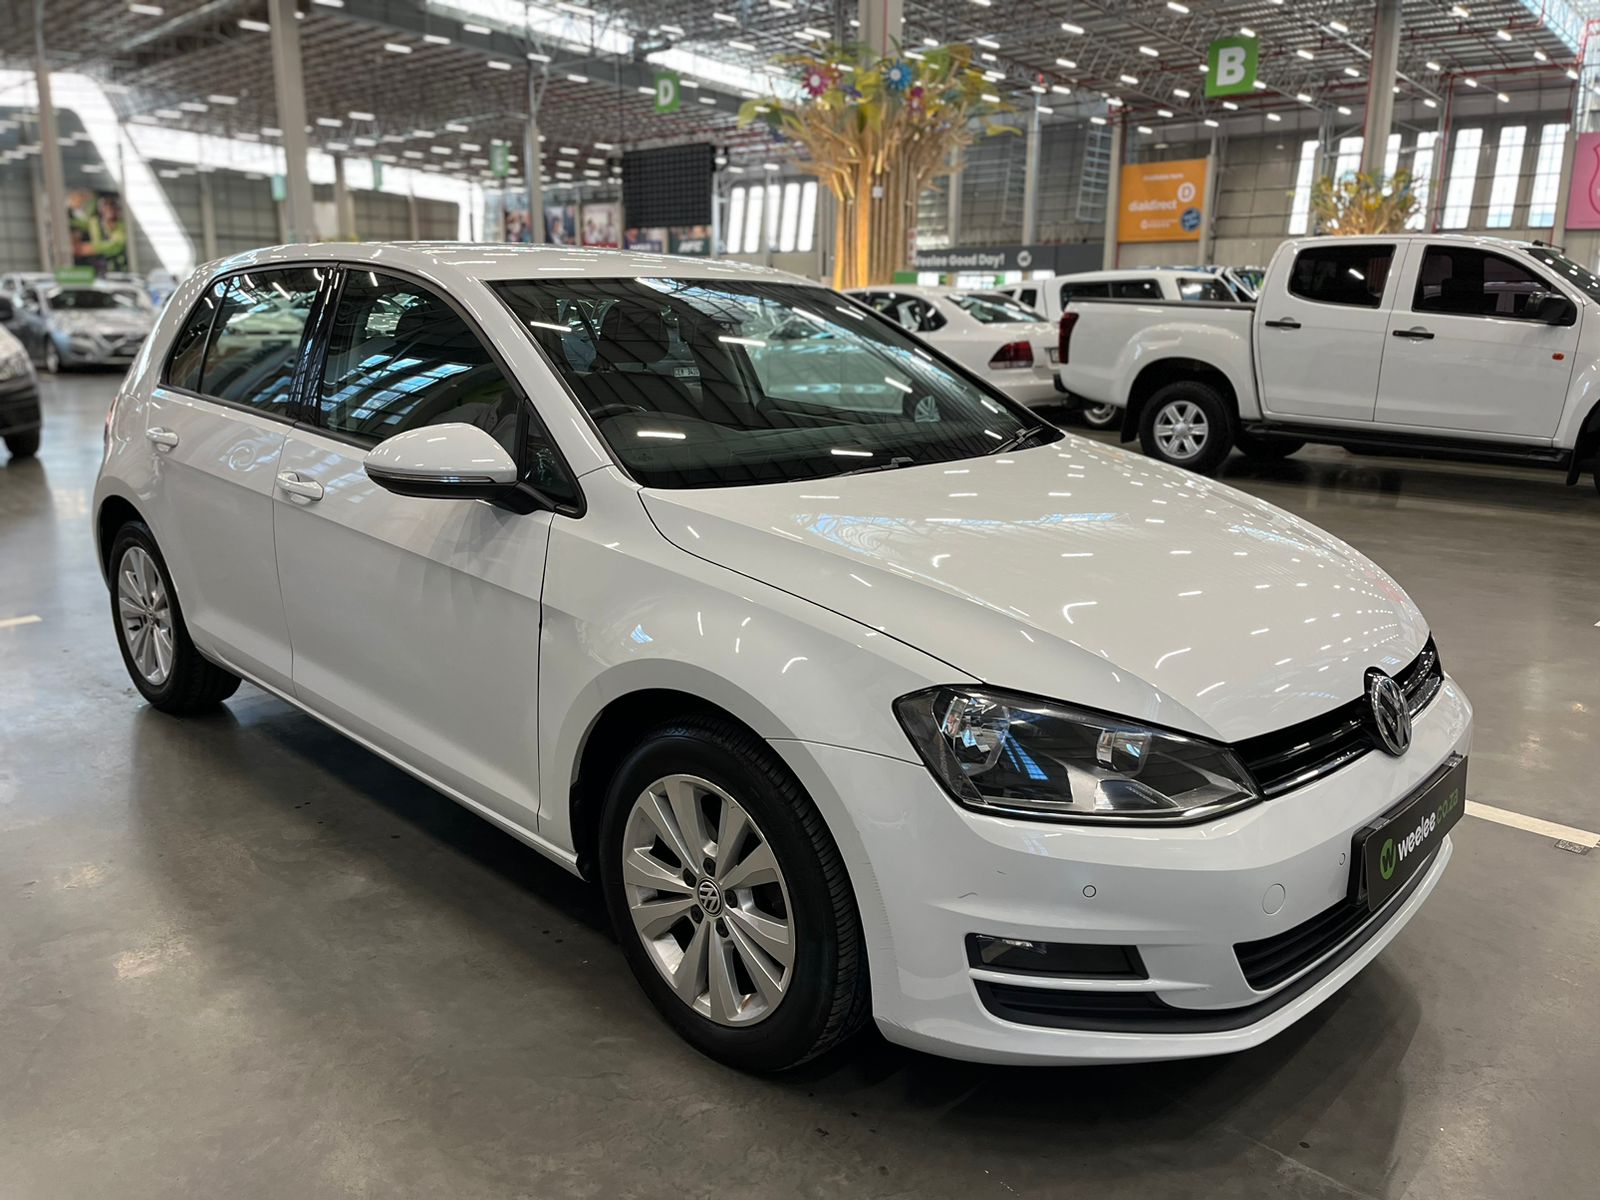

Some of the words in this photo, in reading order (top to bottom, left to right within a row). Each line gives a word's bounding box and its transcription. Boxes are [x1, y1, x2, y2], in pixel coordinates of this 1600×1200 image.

[1216, 46, 1246, 87] B
[658, 78, 675, 106] D
[948, 253, 977, 267] Good
[978, 252, 1006, 269] Day!
